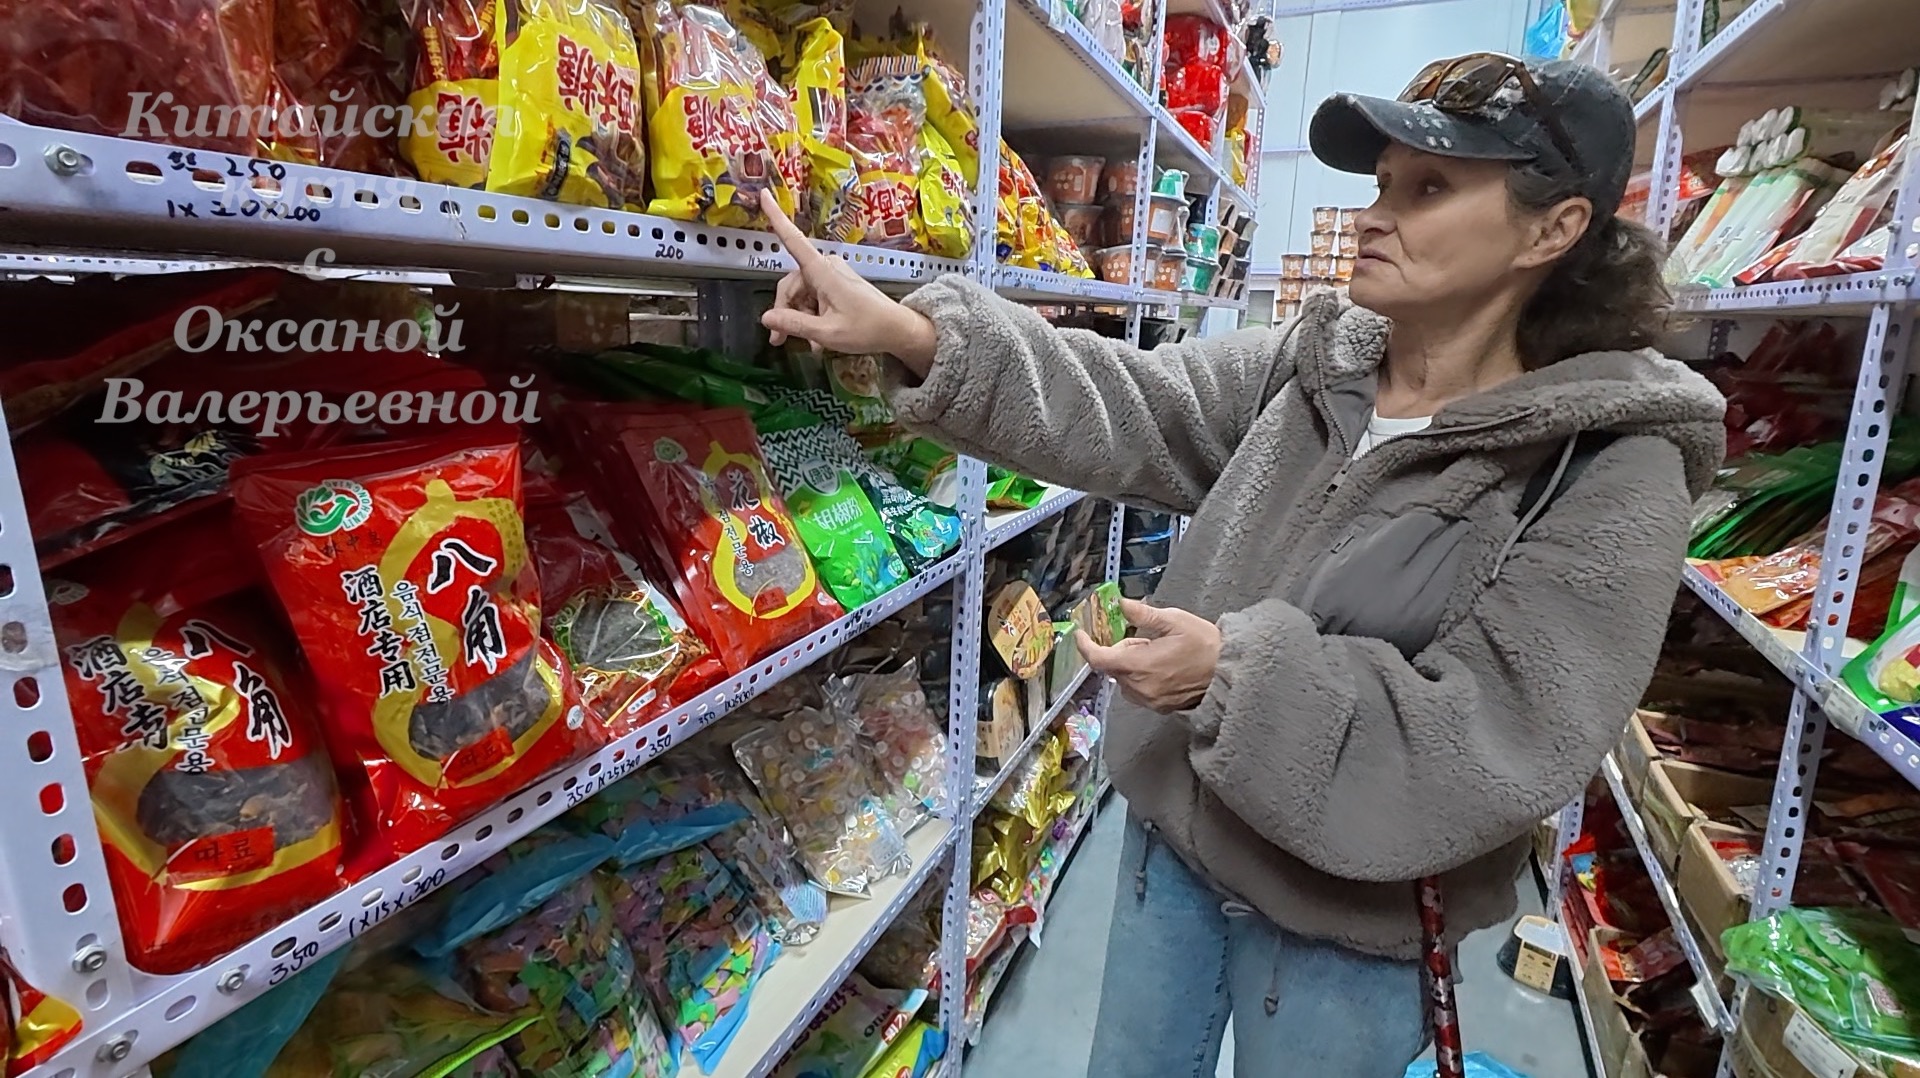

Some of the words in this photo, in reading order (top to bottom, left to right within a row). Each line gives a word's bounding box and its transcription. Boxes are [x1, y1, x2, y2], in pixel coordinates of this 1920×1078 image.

[225, 156, 286, 180] 250
[655, 243, 684, 260] 200
[812, 496, 864, 531] 胡椒粉
[428, 541, 505, 672] 八角
[342, 565, 416, 698] 酒店专用
[182, 620, 292, 760] 八角
[649, 734, 672, 757] 350
[566, 781, 593, 809] 350
[269, 941, 319, 985] 350
